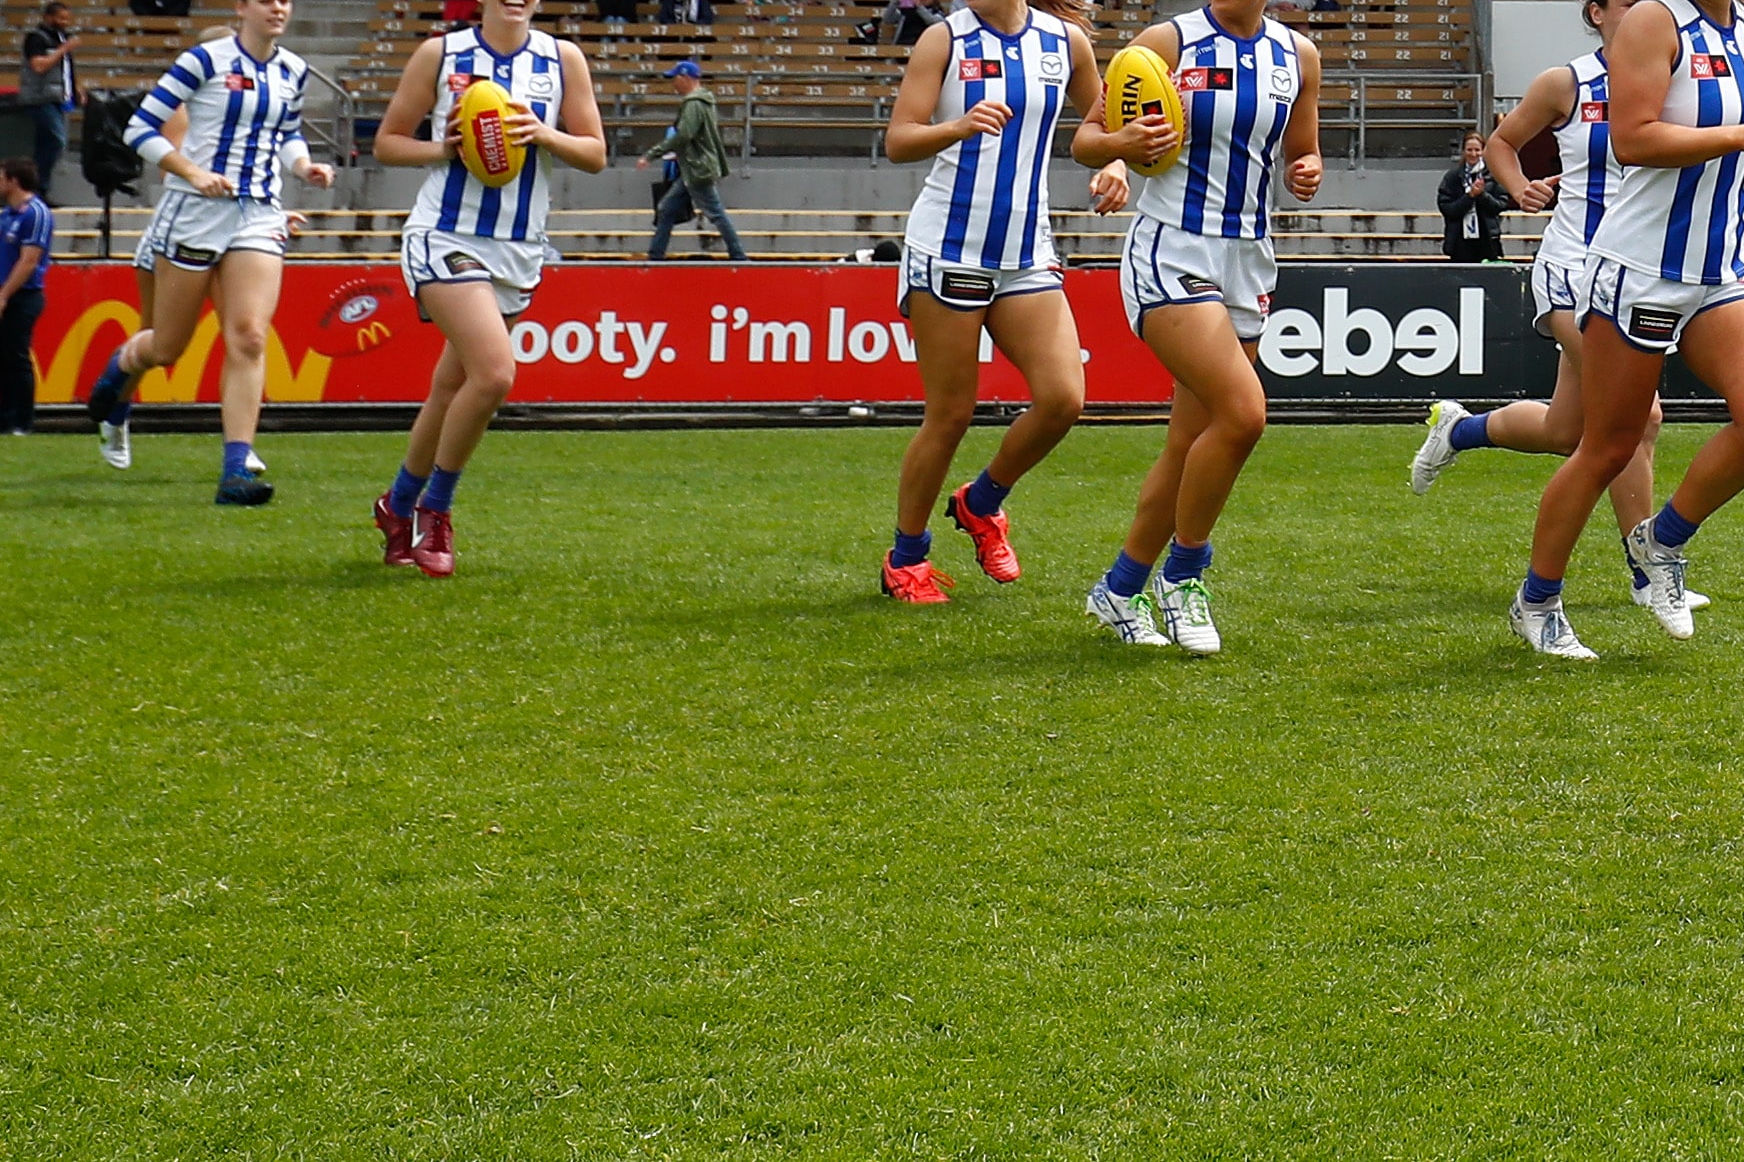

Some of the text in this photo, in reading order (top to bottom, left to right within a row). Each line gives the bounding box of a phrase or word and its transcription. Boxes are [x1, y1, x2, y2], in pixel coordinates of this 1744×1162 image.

[511, 311, 677, 379] ooty.
[709, 304, 812, 363] i'm
[1259, 287, 1486, 377] ebel
